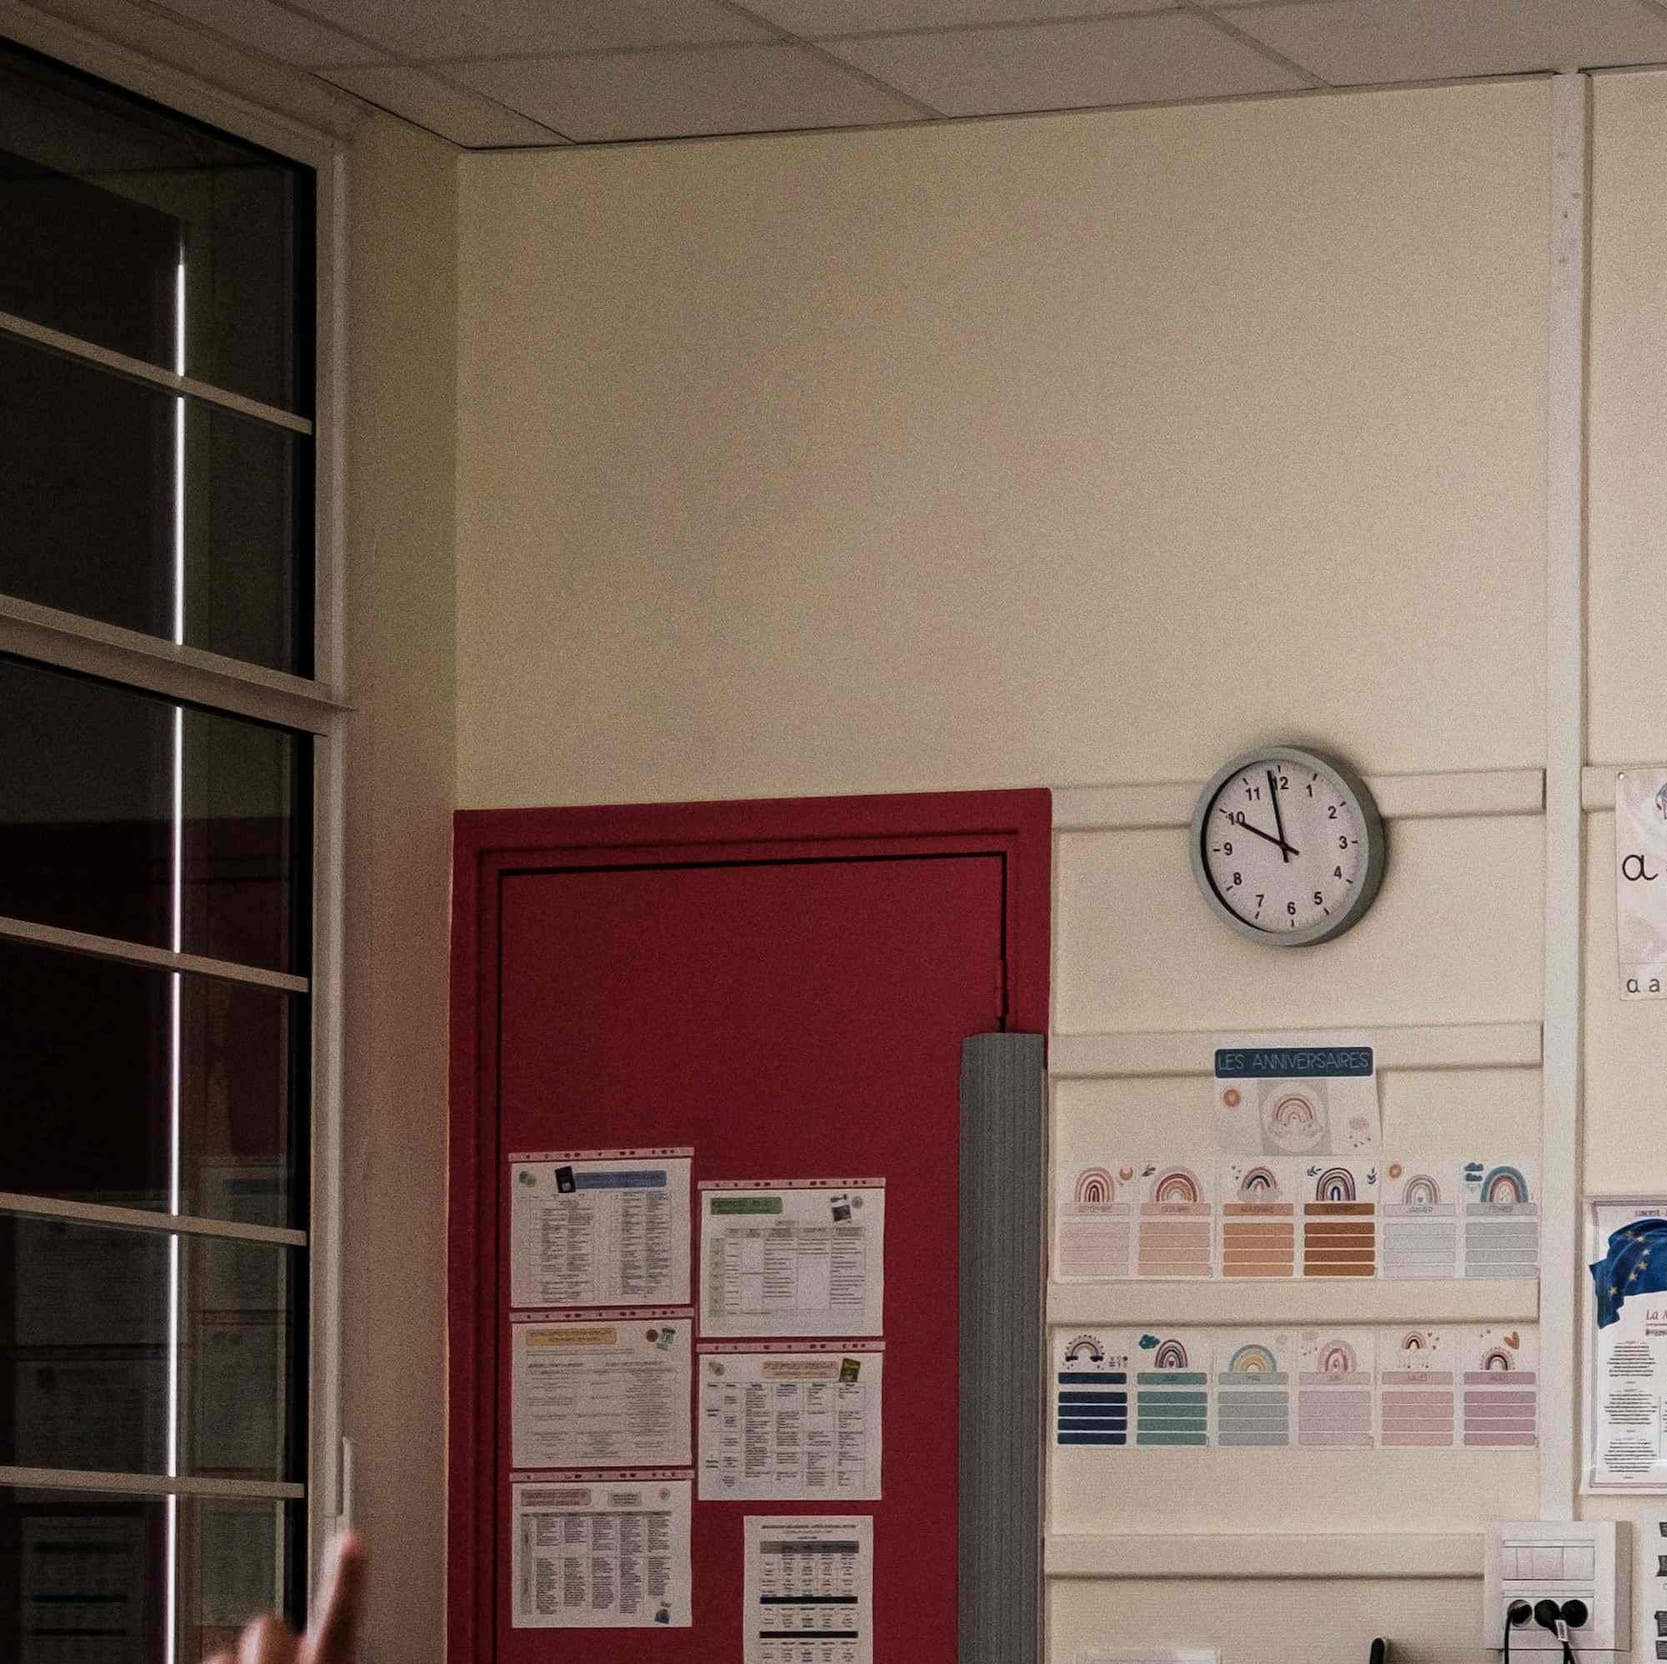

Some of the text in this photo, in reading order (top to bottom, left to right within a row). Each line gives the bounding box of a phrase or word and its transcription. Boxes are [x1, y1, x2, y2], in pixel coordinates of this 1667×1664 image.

[1245, 786, 1261, 801] 11
[1305, 783, 1313, 798] 1
[1227, 810, 1246, 826] 10
[1327, 805, 1338, 820] 2
[1223, 841, 1233, 857] 9
[1338, 835, 1349, 850] 3
[1333, 865, 1343, 880] 4
[1621, 854, 1659, 882] a
[1232, 871, 1243, 886] 8
[1255, 893, 1265, 908] 7
[1313, 891, 1324, 906] 5
[1286, 901, 1297, 916] 6
[1218, 1051, 1369, 1071] LES ANNIVERSAIRES
[1645, 1309, 1659, 1321] La
